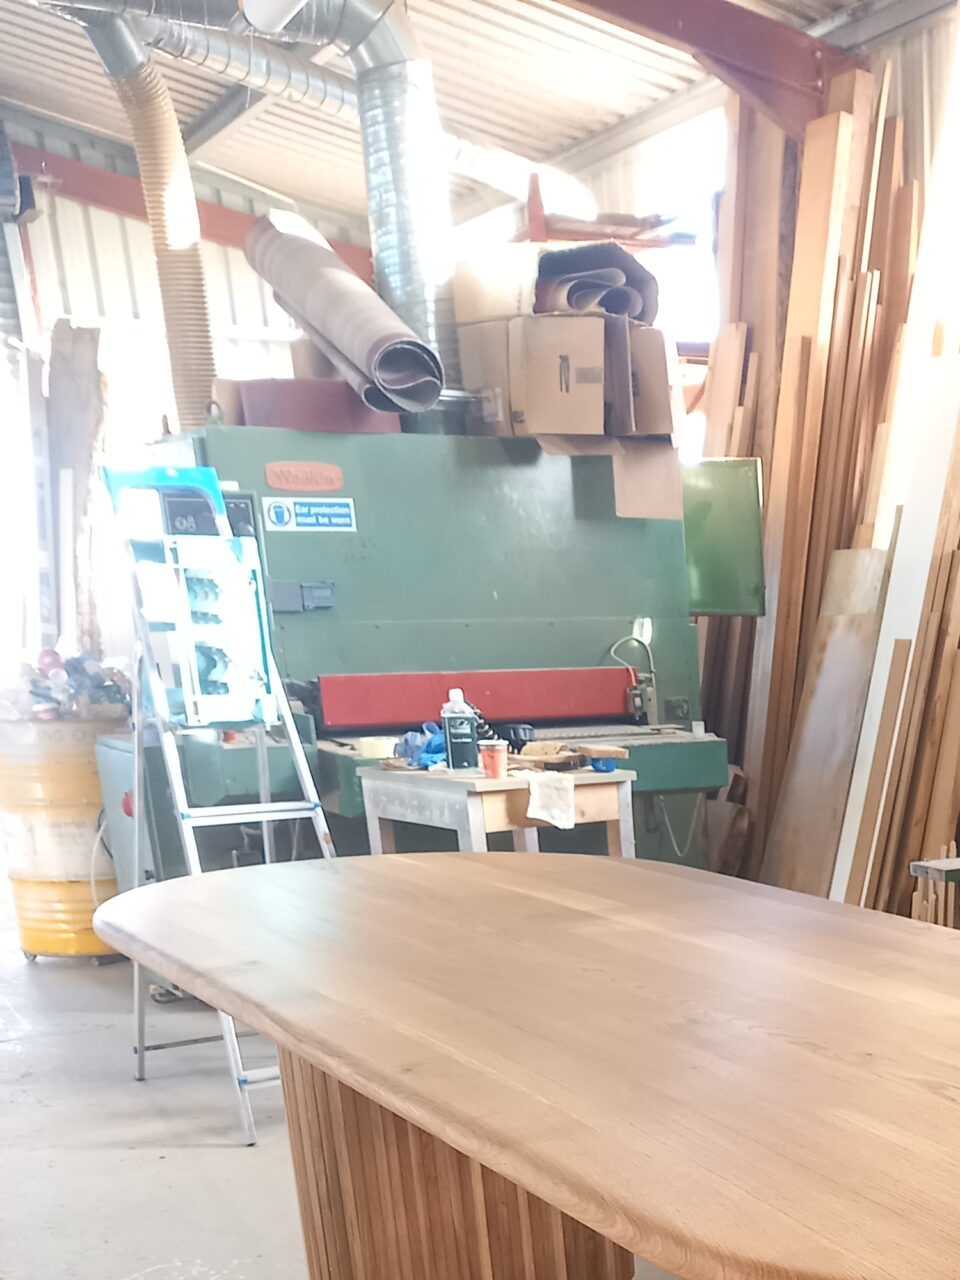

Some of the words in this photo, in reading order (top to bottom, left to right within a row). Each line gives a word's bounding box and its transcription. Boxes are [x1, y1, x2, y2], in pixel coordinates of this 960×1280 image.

[295, 504, 309, 514] Ear
[310, 505, 351, 516] protection
[296, 515, 317, 524] must
[318, 515, 330, 524] be
[331, 516, 352, 525] worn
